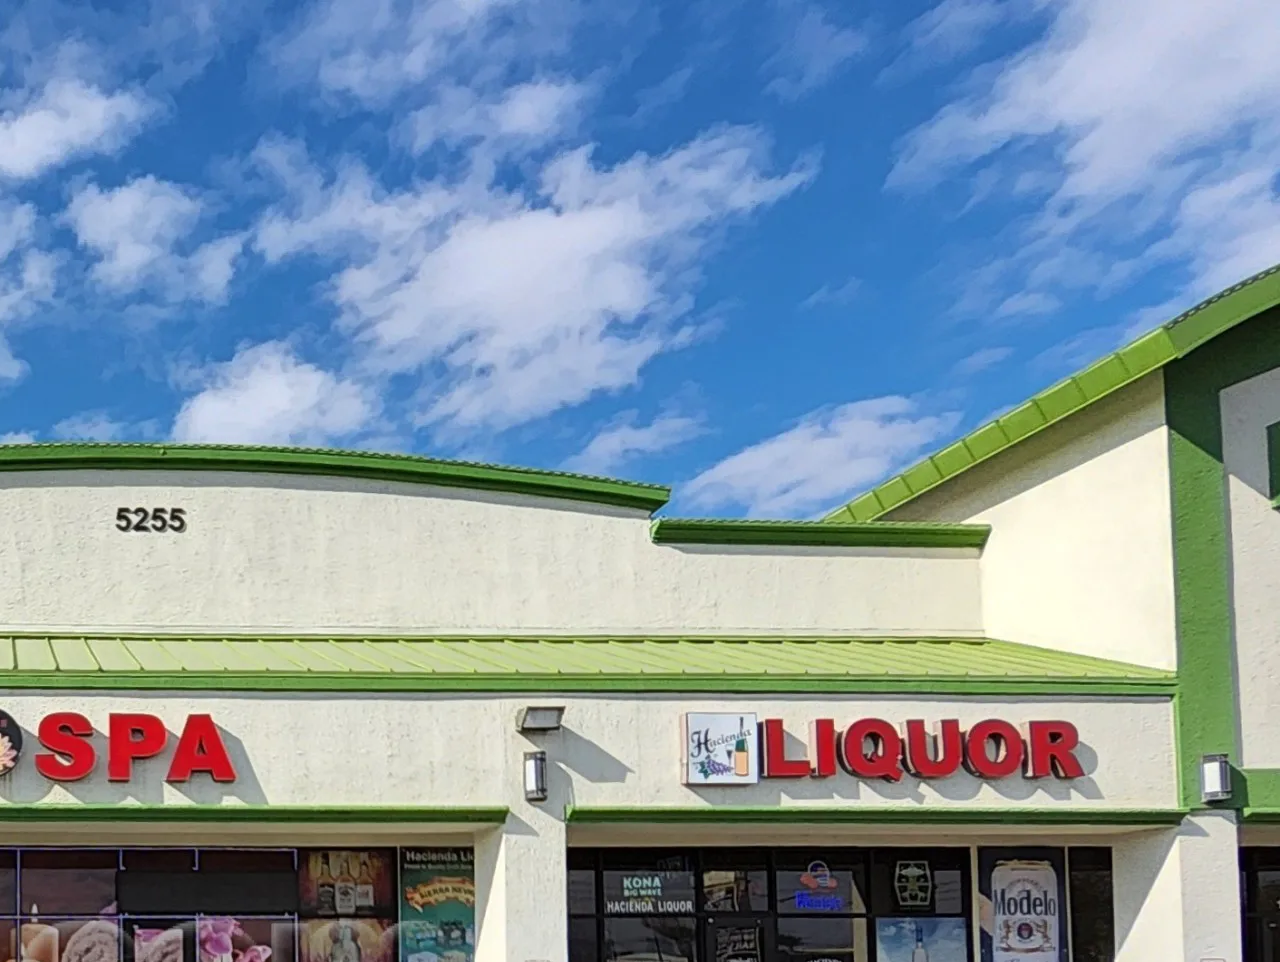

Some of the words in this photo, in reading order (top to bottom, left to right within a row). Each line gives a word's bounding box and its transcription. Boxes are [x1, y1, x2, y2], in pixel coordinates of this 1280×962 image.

[115, 507, 187, 533] 5255
[35, 712, 237, 782] SPA
[691, 727, 752, 758] Hacienda
[763, 718, 1085, 783] LIQUOR
[406, 850, 458, 862] Hacienda
[623, 877, 661, 888] KONA
[607, 901, 654, 912] HACIENDA
[658, 901, 693, 912] LIQUOR
[994, 889, 1057, 917] Modelo
